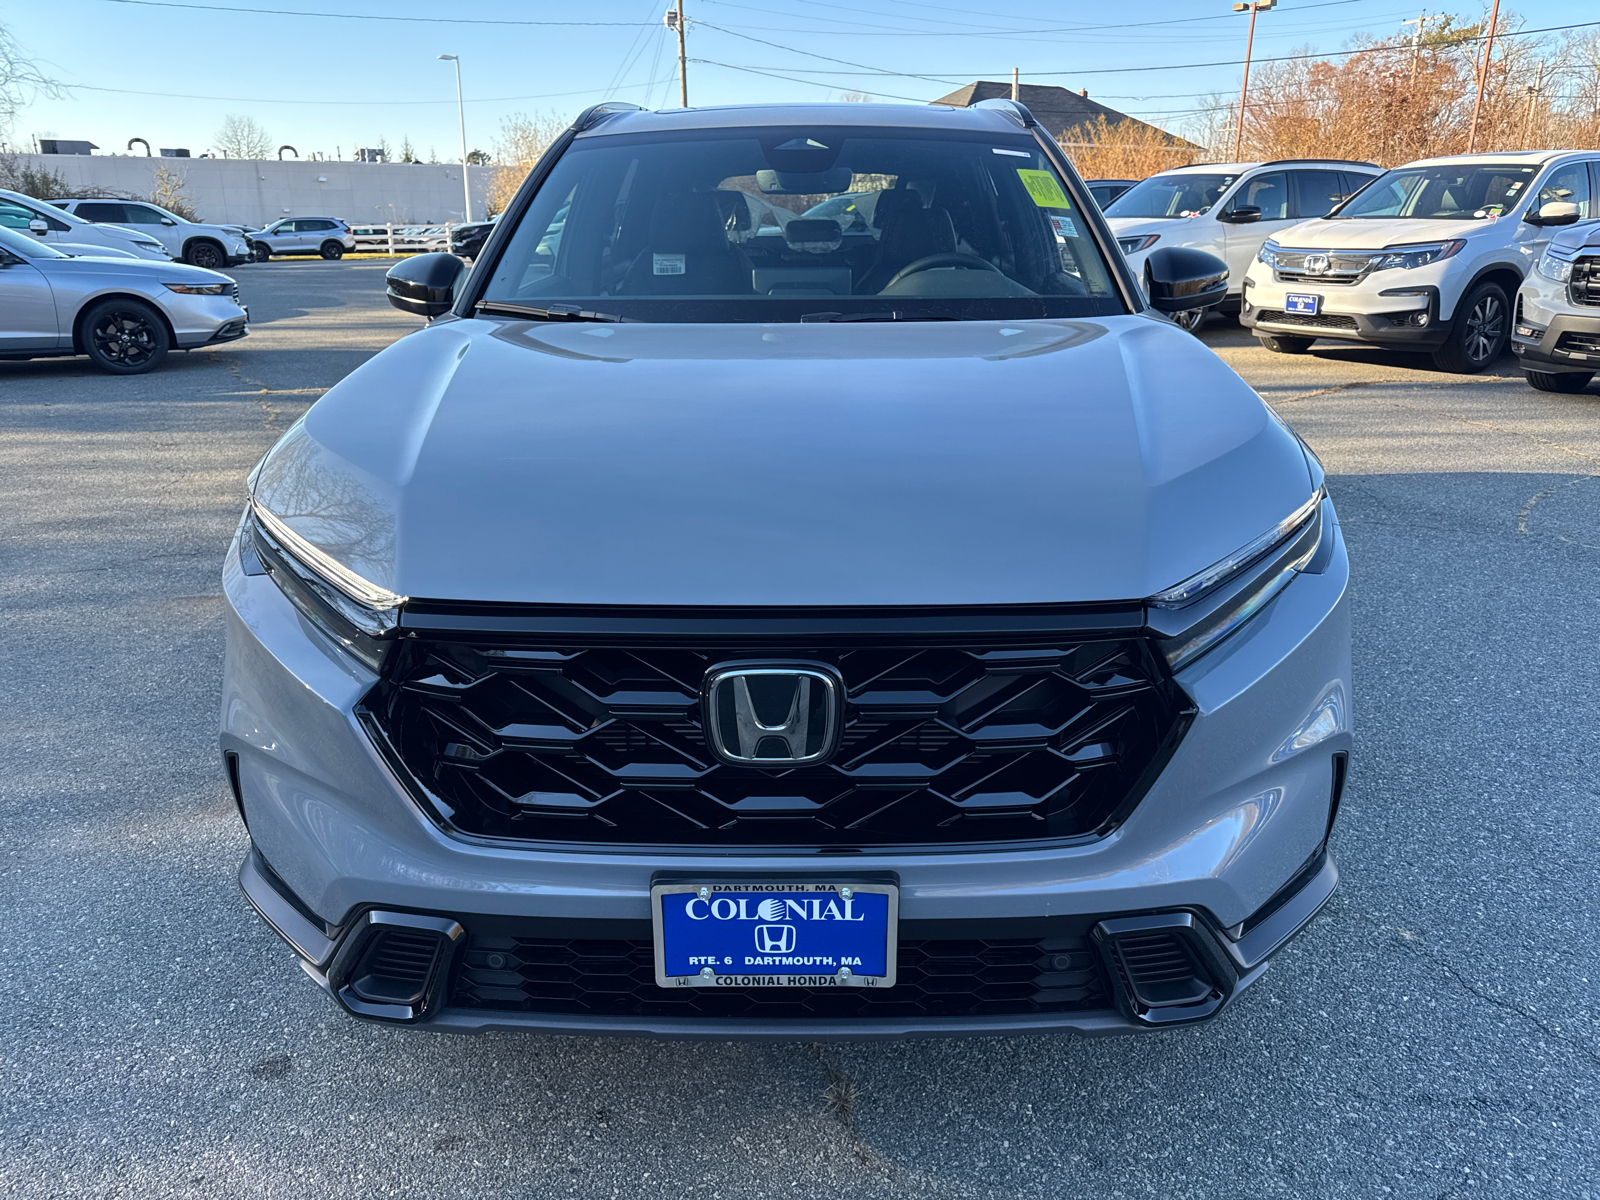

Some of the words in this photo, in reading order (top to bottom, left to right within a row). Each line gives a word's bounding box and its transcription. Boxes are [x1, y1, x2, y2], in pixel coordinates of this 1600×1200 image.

[815, 884, 837, 892] MA
[685, 898, 865, 921] COLONIAL
[689, 956, 721, 966] RTE.
[723, 956, 733, 966] 6
[744, 956, 837, 967] DARTMOUTH,
[840, 956, 862, 966] MA
[715, 976, 784, 987] COLONIAL
[787, 975, 837, 986] HONDA
